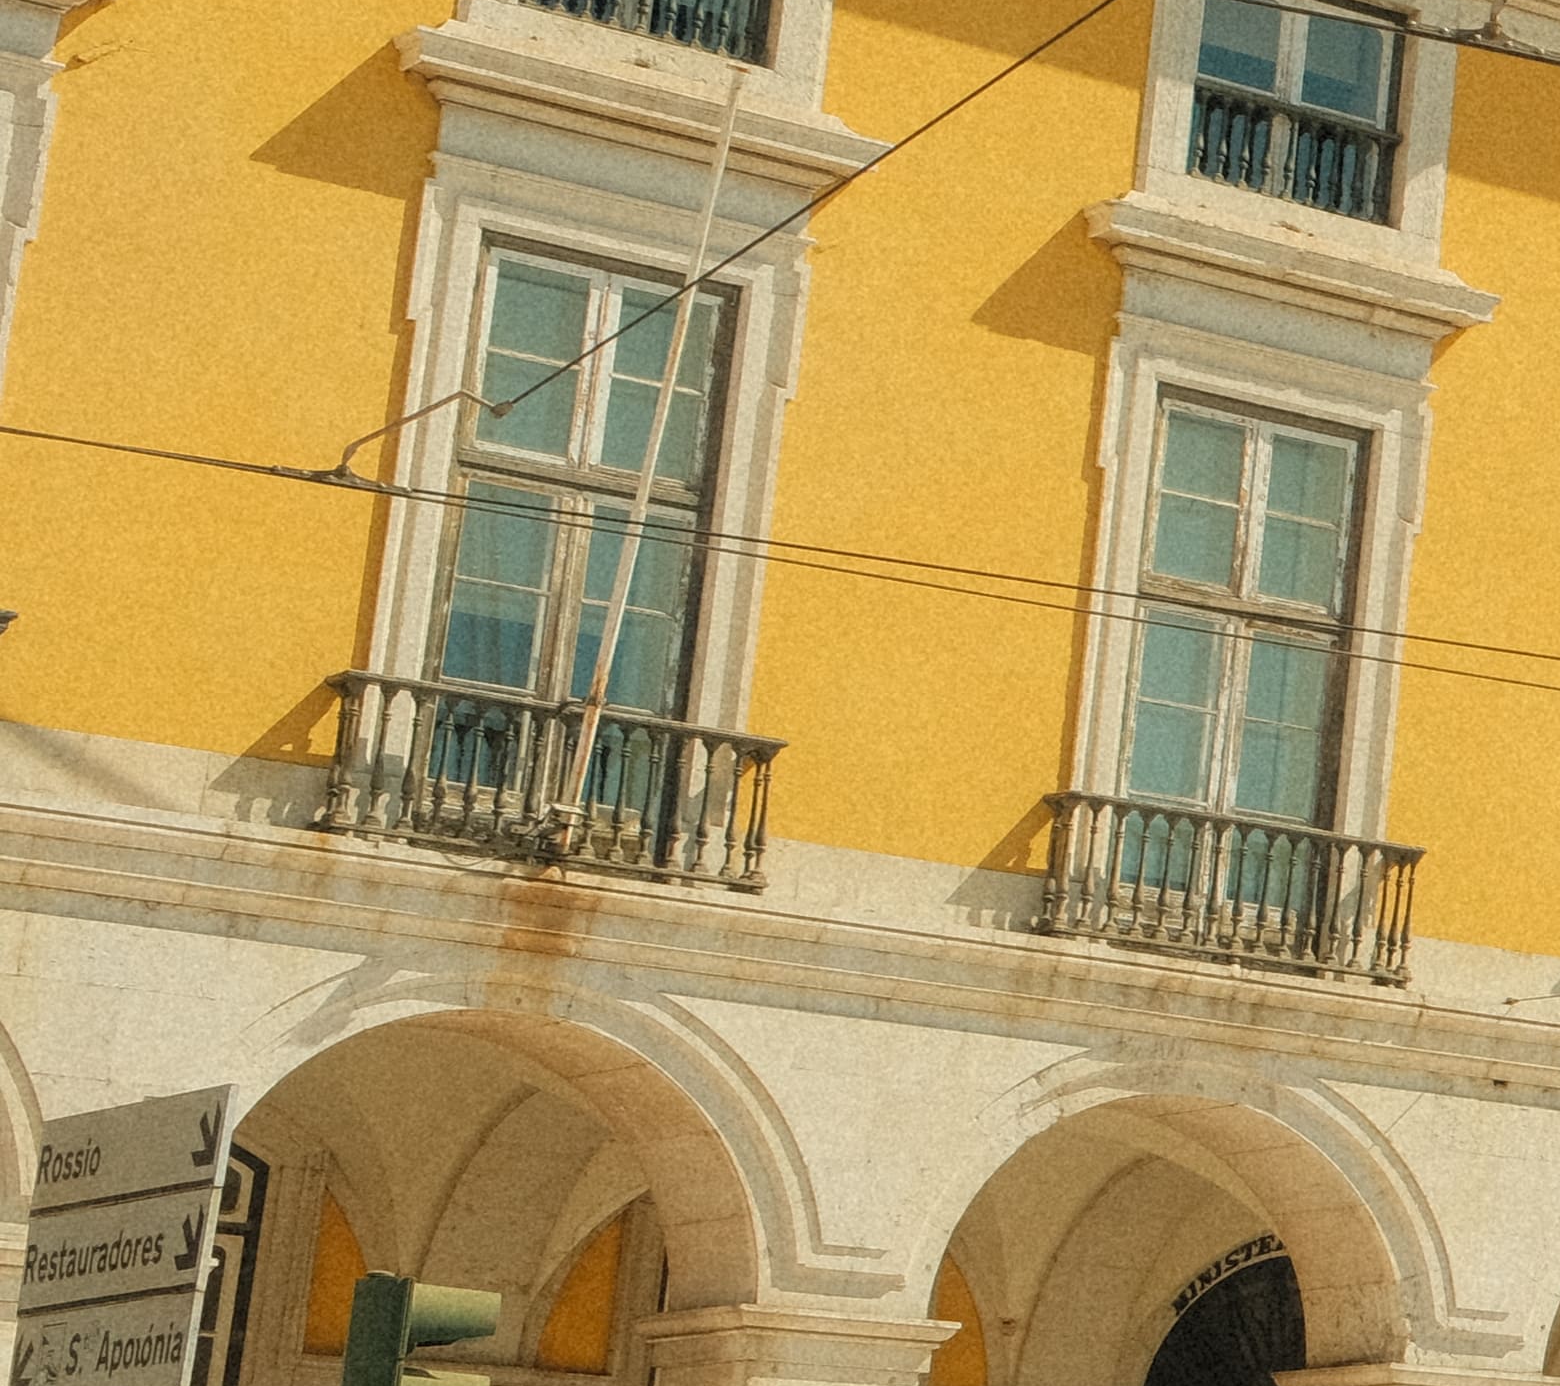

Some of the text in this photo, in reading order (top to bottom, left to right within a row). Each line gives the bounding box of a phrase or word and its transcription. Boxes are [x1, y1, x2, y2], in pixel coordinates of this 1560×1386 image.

[36, 1138, 100, 1185] Rossio
[23, 1229, 164, 1285] Restauradores
[95, 1322, 183, 1378] Apolónia
